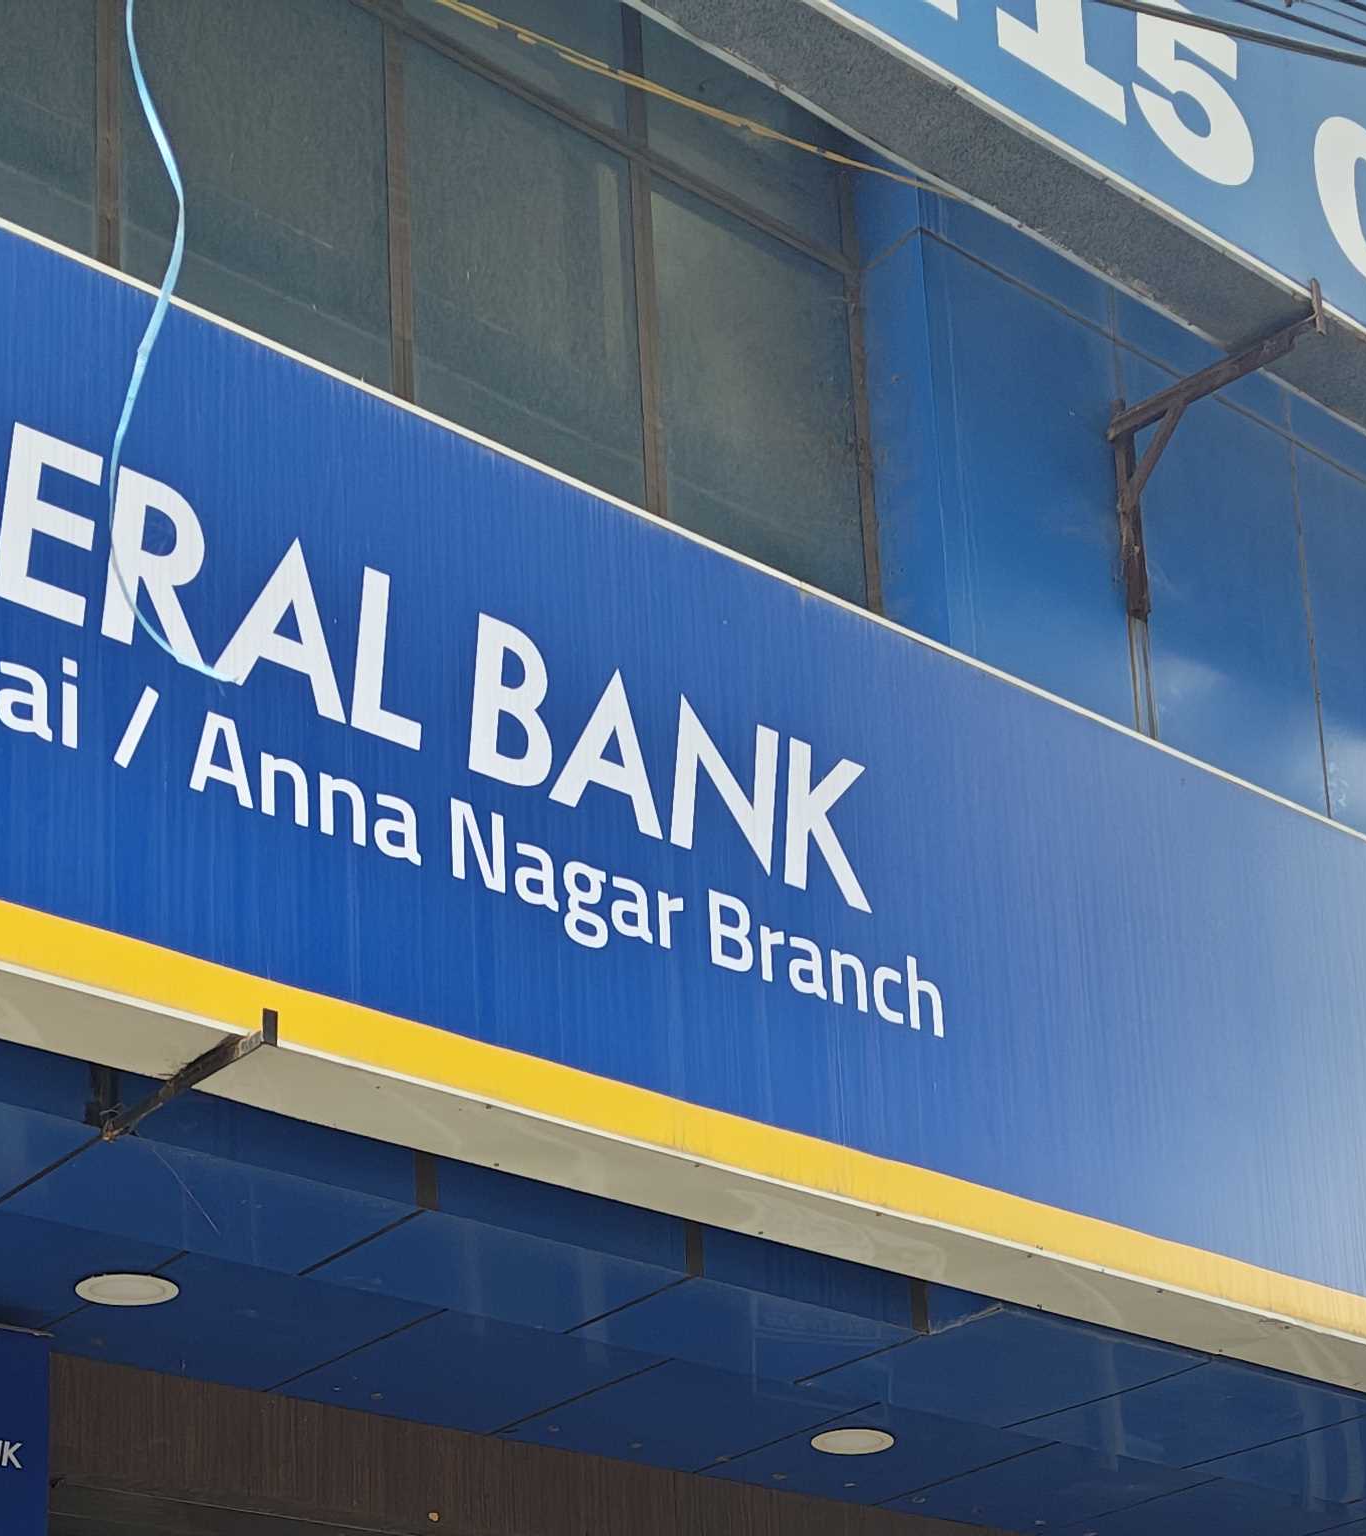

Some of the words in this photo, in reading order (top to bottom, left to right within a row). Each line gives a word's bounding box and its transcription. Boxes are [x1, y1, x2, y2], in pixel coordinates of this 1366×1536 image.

[189, 711, 422, 867] Anna
[450, 797, 684, 949] Nagar
[708, 888, 946, 1039] Branch
[469, 612, 872, 914] BANK
